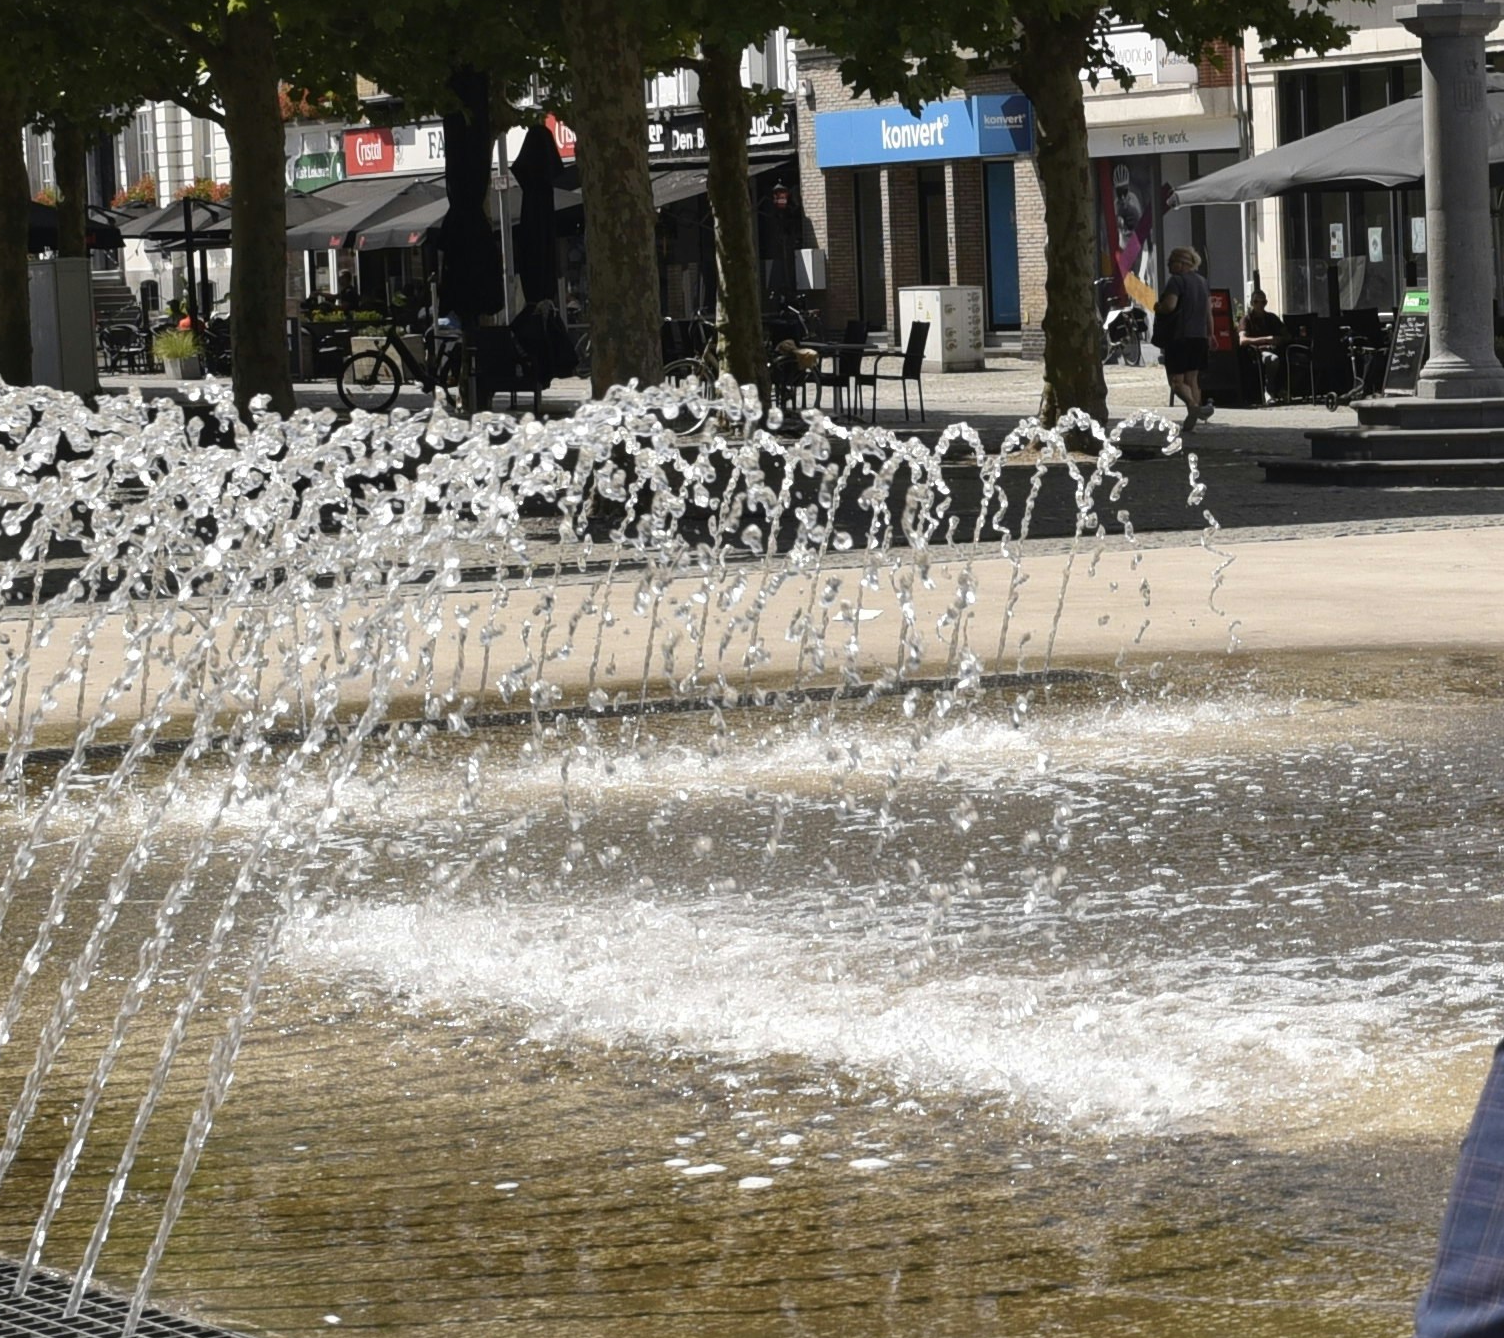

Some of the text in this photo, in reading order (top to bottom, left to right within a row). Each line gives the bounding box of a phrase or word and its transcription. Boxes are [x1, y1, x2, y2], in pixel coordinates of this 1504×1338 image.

[672, 129, 693, 151] Den
[1122, 134, 1135, 147] For
[1153, 131, 1165, 144] For
[356, 137, 383, 166] Cristal
